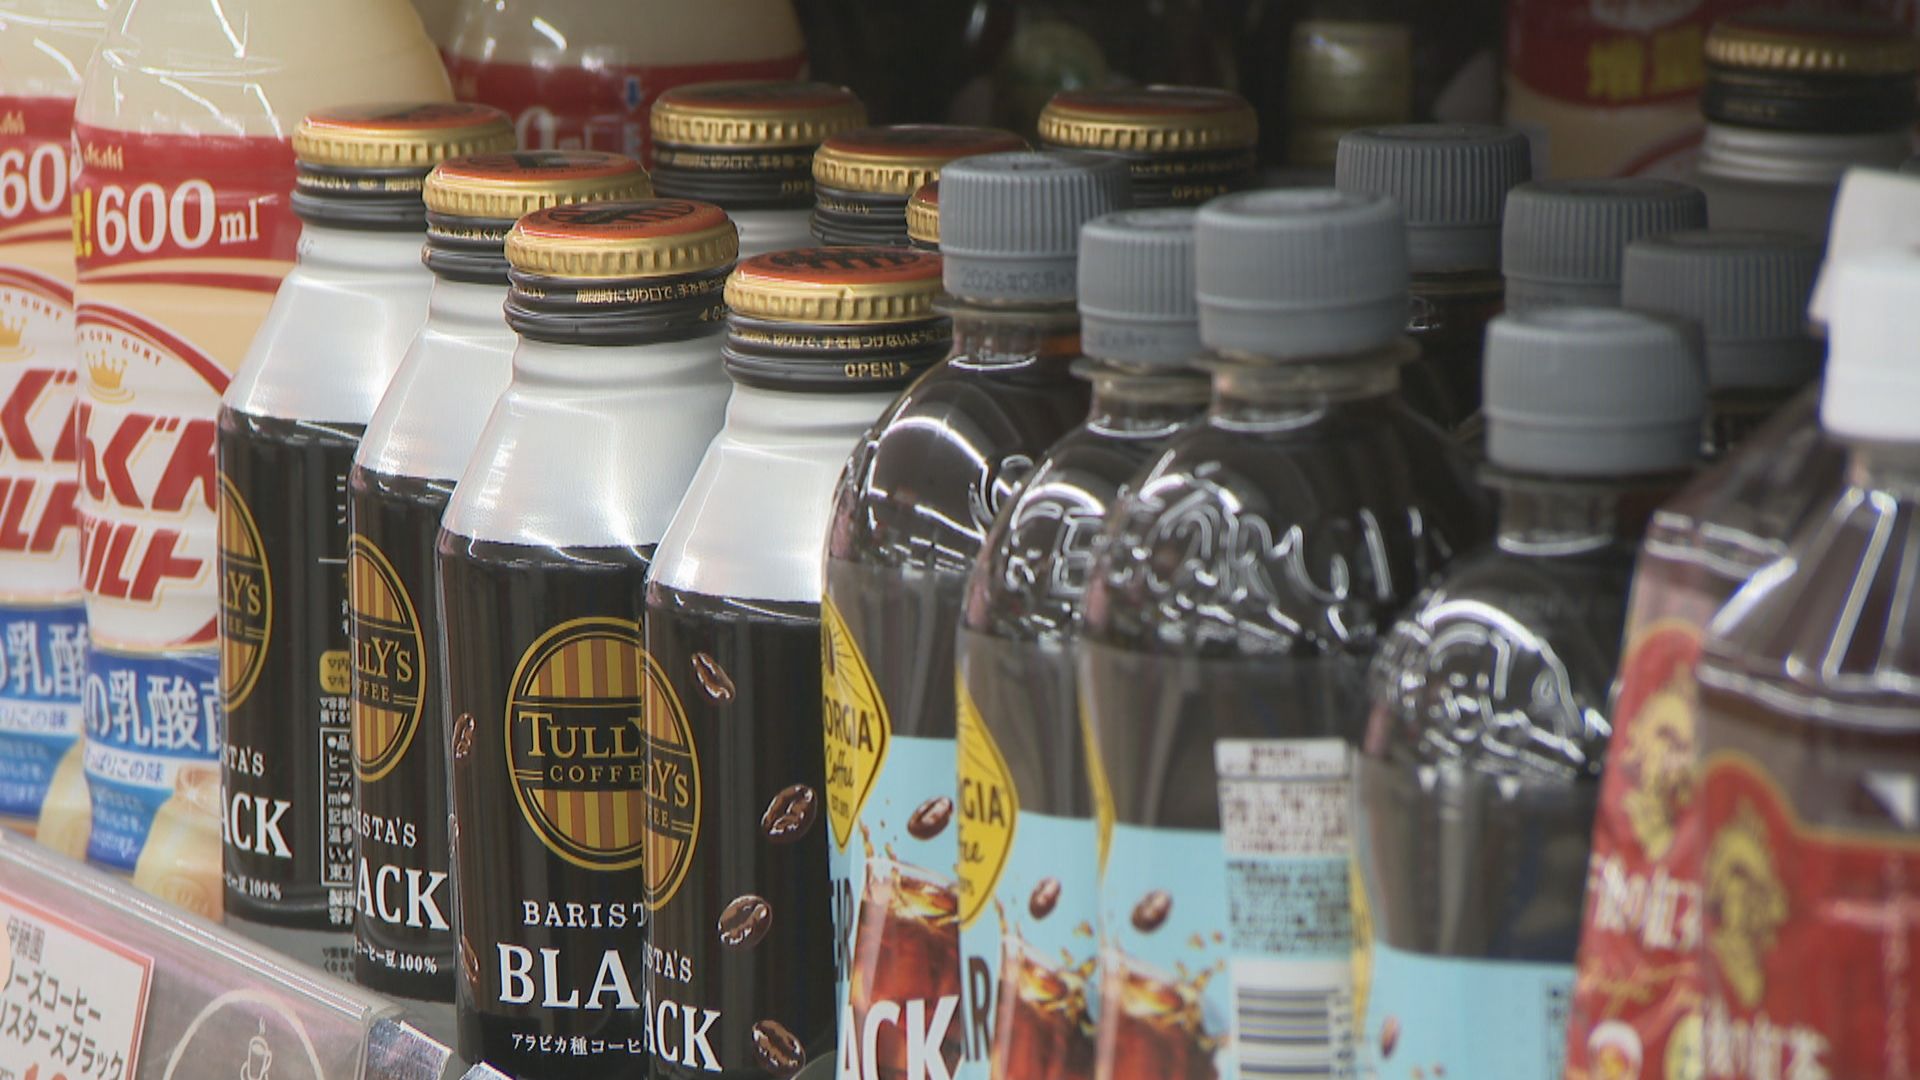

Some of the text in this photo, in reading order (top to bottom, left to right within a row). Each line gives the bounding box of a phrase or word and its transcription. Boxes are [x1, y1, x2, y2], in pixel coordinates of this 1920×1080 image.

[0, 142, 82, 218] 60
[97, 179, 258, 256] 600ml
[844, 361, 894, 379] OPEN
[356, 857, 450, 931] ACK
[496, 941, 641, 1010] BLA
